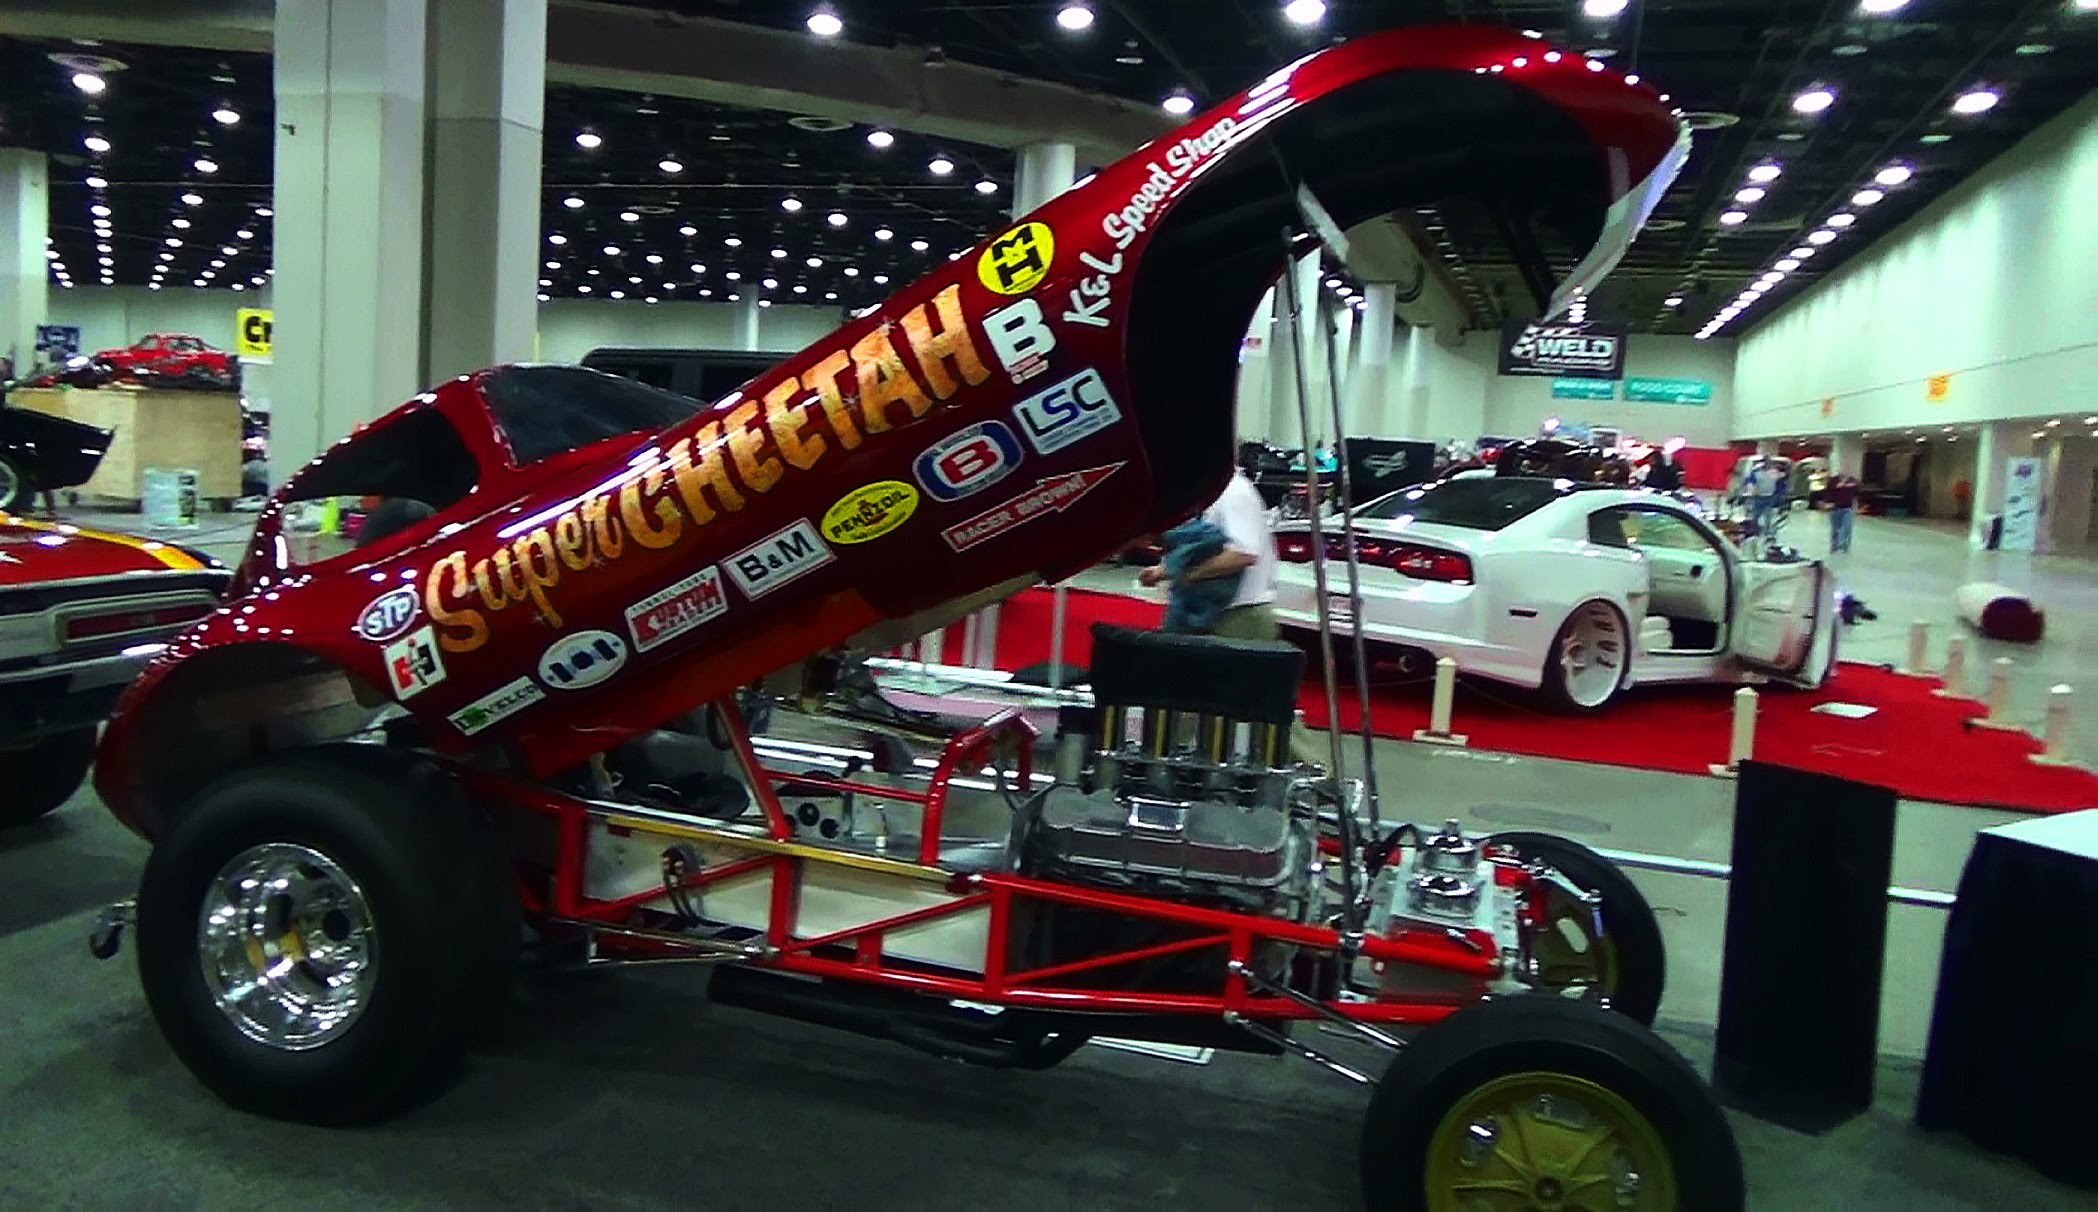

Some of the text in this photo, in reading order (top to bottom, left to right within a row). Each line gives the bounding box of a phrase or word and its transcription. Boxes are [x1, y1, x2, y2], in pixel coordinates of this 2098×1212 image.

[1102, 161, 1176, 249] Speed
[982, 298, 1056, 372] B
[1536, 338, 1613, 358] WELD
[619, 284, 990, 549] CHEETAH
[1020, 375, 1107, 437] LSC
[939, 440, 998, 485] B
[830, 490, 911, 538] PENNZOIL
[736, 531, 815, 582] B&M
[365, 595, 412, 635] STP
